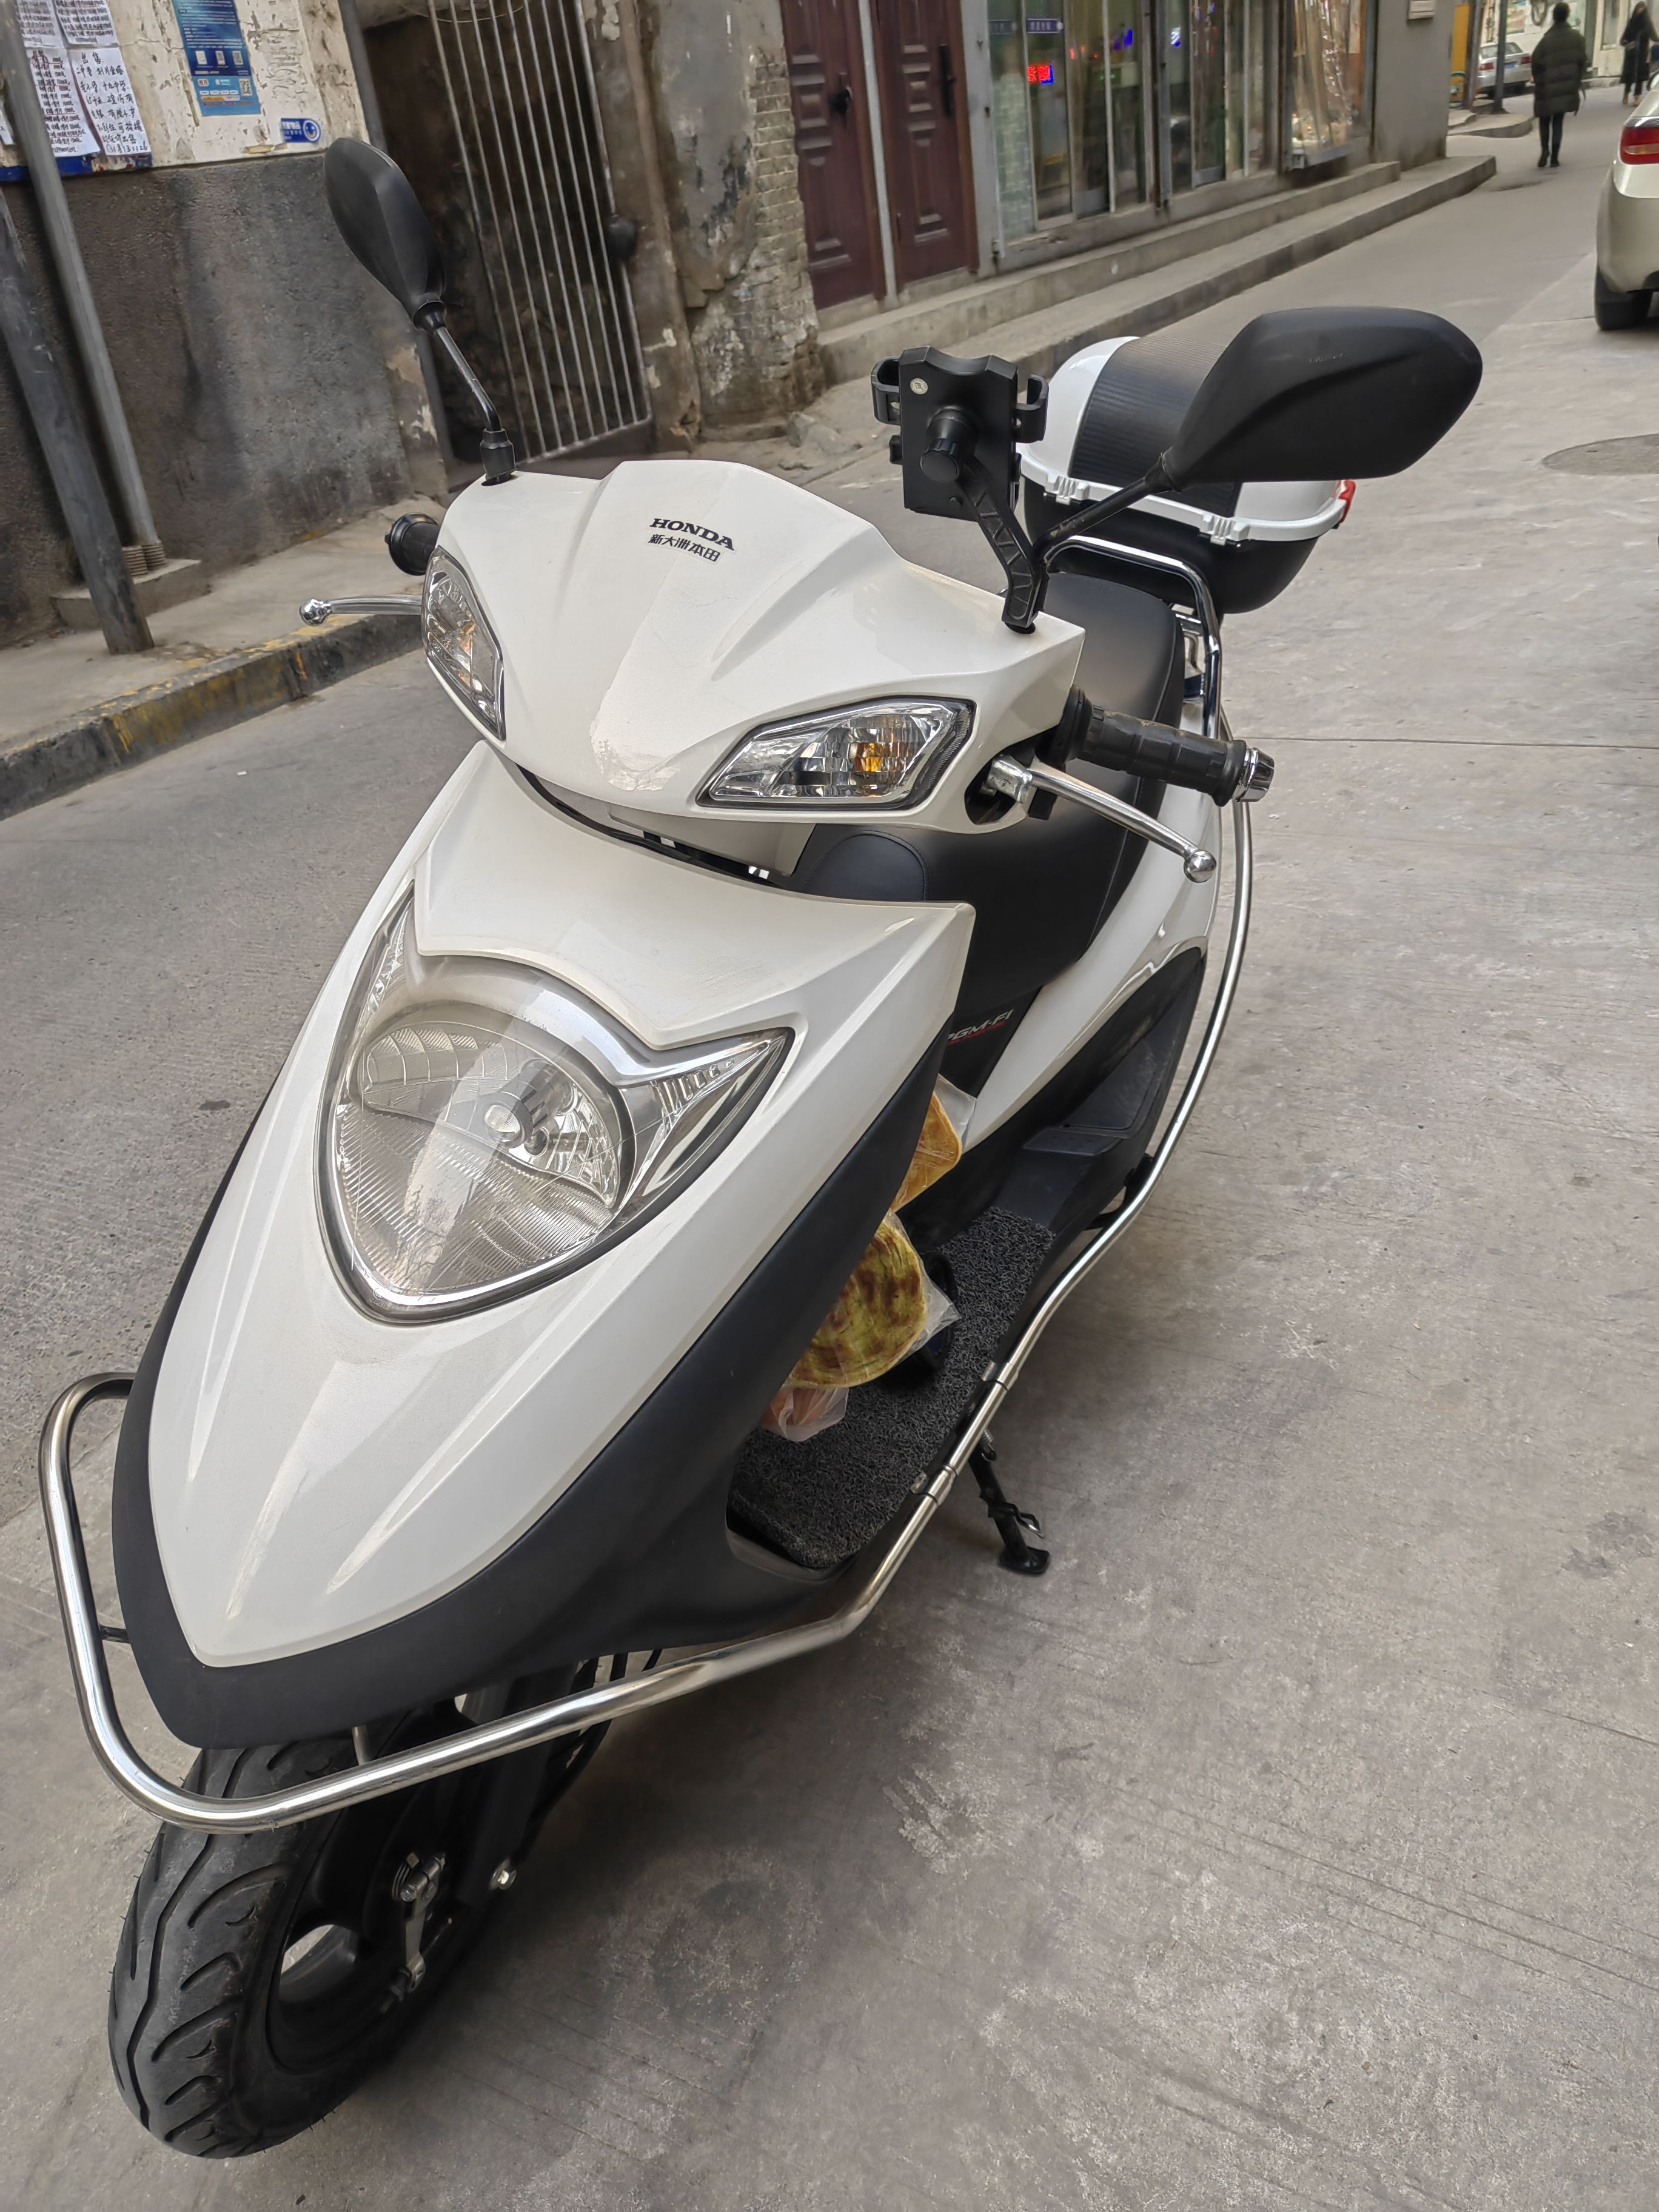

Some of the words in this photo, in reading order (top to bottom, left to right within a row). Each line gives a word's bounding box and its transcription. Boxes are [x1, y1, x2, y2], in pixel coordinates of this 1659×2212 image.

[648, 534, 721, 562] 新大洲本田
[649, 518, 735, 551] HONDA
